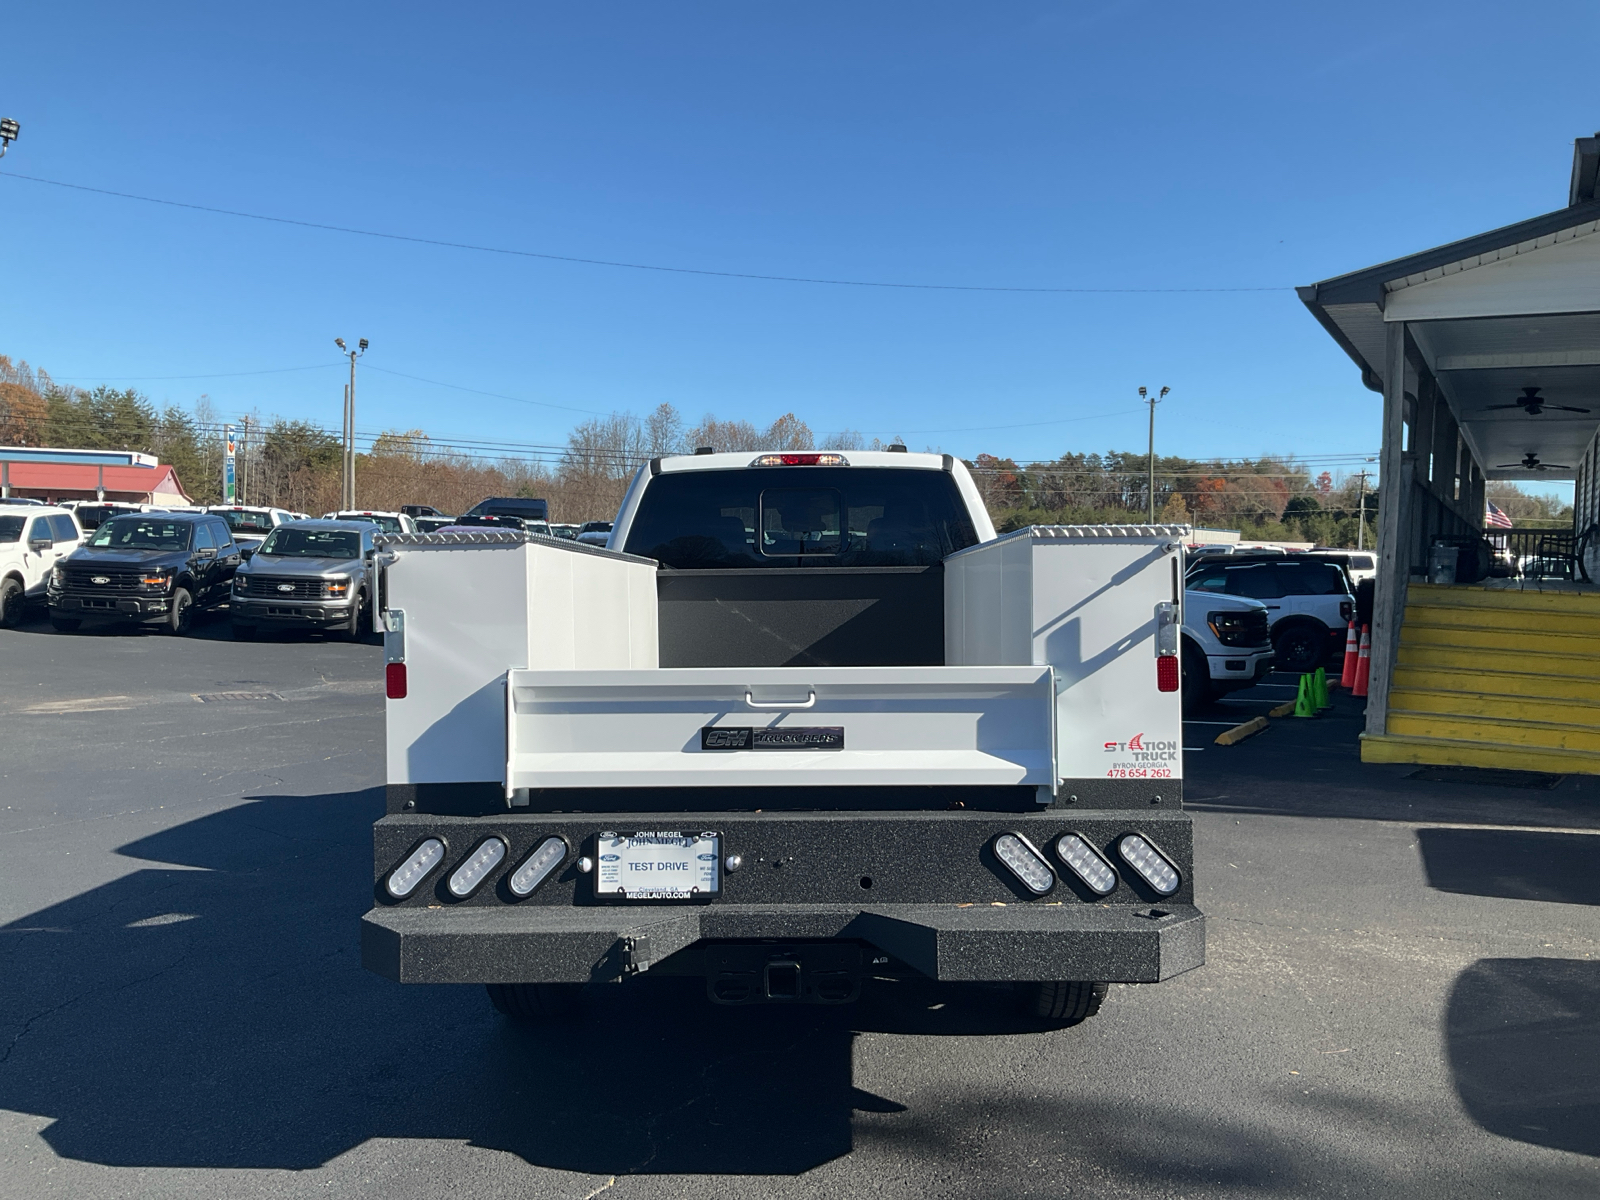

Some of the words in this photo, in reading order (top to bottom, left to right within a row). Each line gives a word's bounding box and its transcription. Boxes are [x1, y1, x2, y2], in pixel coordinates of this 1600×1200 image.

[706, 730, 749, 747] CM
[758, 733, 802, 743] TRUCK
[1104, 733, 1177, 752] STATION
[1132, 751, 1177, 761] TRUCK
[1138, 761, 1168, 769] GEORGIA
[1107, 769, 1126, 778] 478
[1128, 769, 1147, 778] 654
[1150, 768, 1171, 778] 2612
[626, 837, 653, 849] JOHN
[628, 862, 655, 871] TEST
[657, 862, 689, 871] DRIVE
